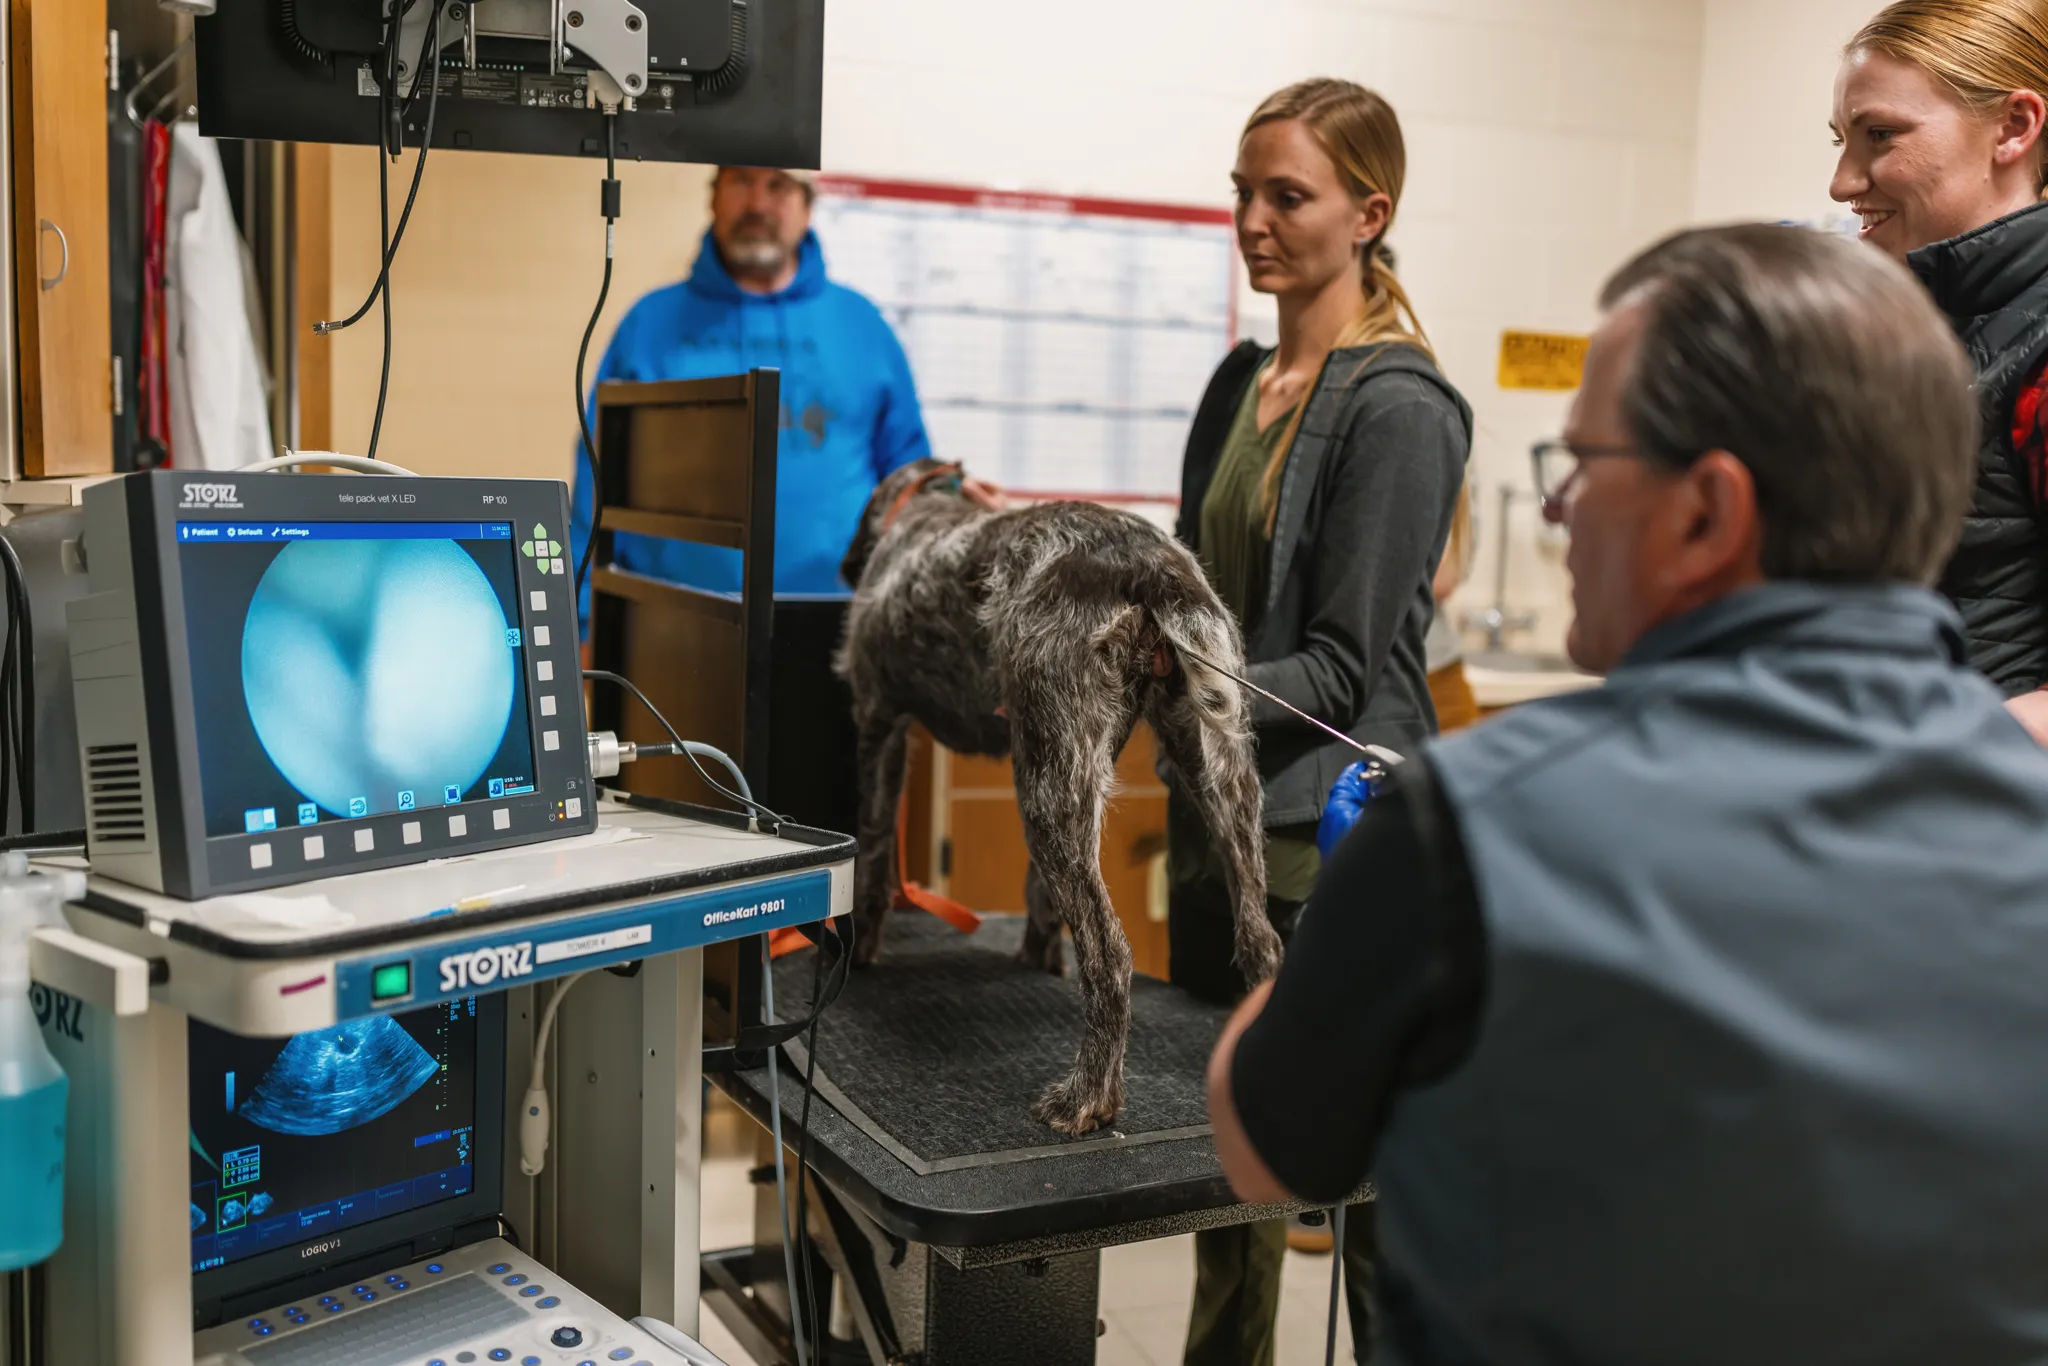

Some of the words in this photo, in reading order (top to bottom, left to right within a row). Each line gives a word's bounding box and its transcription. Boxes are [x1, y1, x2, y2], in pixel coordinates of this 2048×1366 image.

[183, 483, 238, 502] STORZ
[339, 494, 354, 503] tele
[356, 494, 376, 504] pack
[378, 494, 390, 503] vet
[391, 494, 399, 503] X
[399, 494, 417, 503] LED
[482, 496, 494, 504] RP
[496, 496, 508, 504] 100
[191, 528, 219, 536] Patient
[237, 528, 263, 536] Default
[281, 528, 310, 537] Settings
[703, 904, 758, 926] OfficeKart
[761, 899, 785, 914] 9801
[440, 941, 533, 992] STORZ
[29, 980, 84, 1042] ORZ
[301, 1243, 328, 1258] LOGIQ
